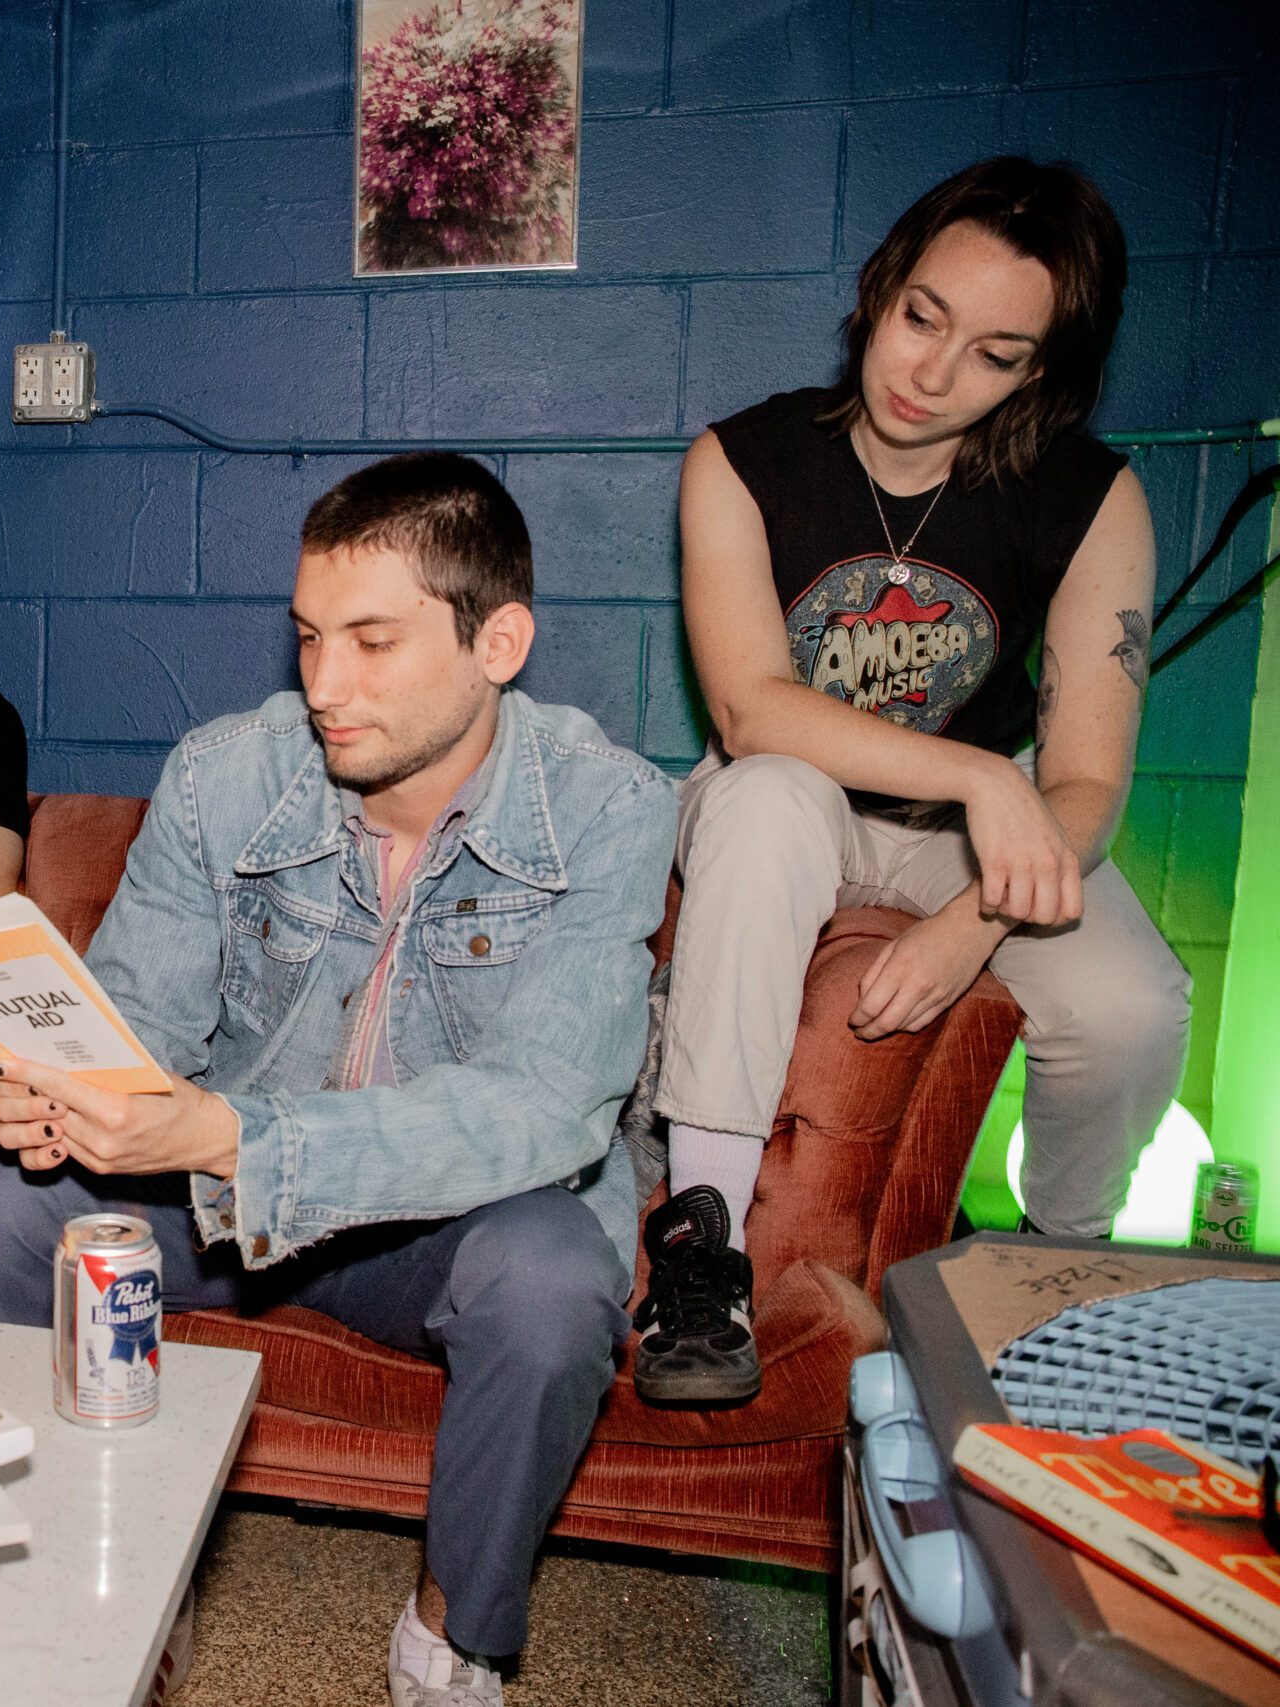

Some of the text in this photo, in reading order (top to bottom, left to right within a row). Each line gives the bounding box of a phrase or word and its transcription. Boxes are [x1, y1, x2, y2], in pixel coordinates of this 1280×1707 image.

[810, 618, 970, 696] AMOEBA
[852, 666, 936, 712] MUSIC
[25, 1010, 66, 1029] AID
[663, 1219, 692, 1243] adidas
[114, 1279, 155, 1307] Pabst
[93, 1306, 130, 1325] Blue
